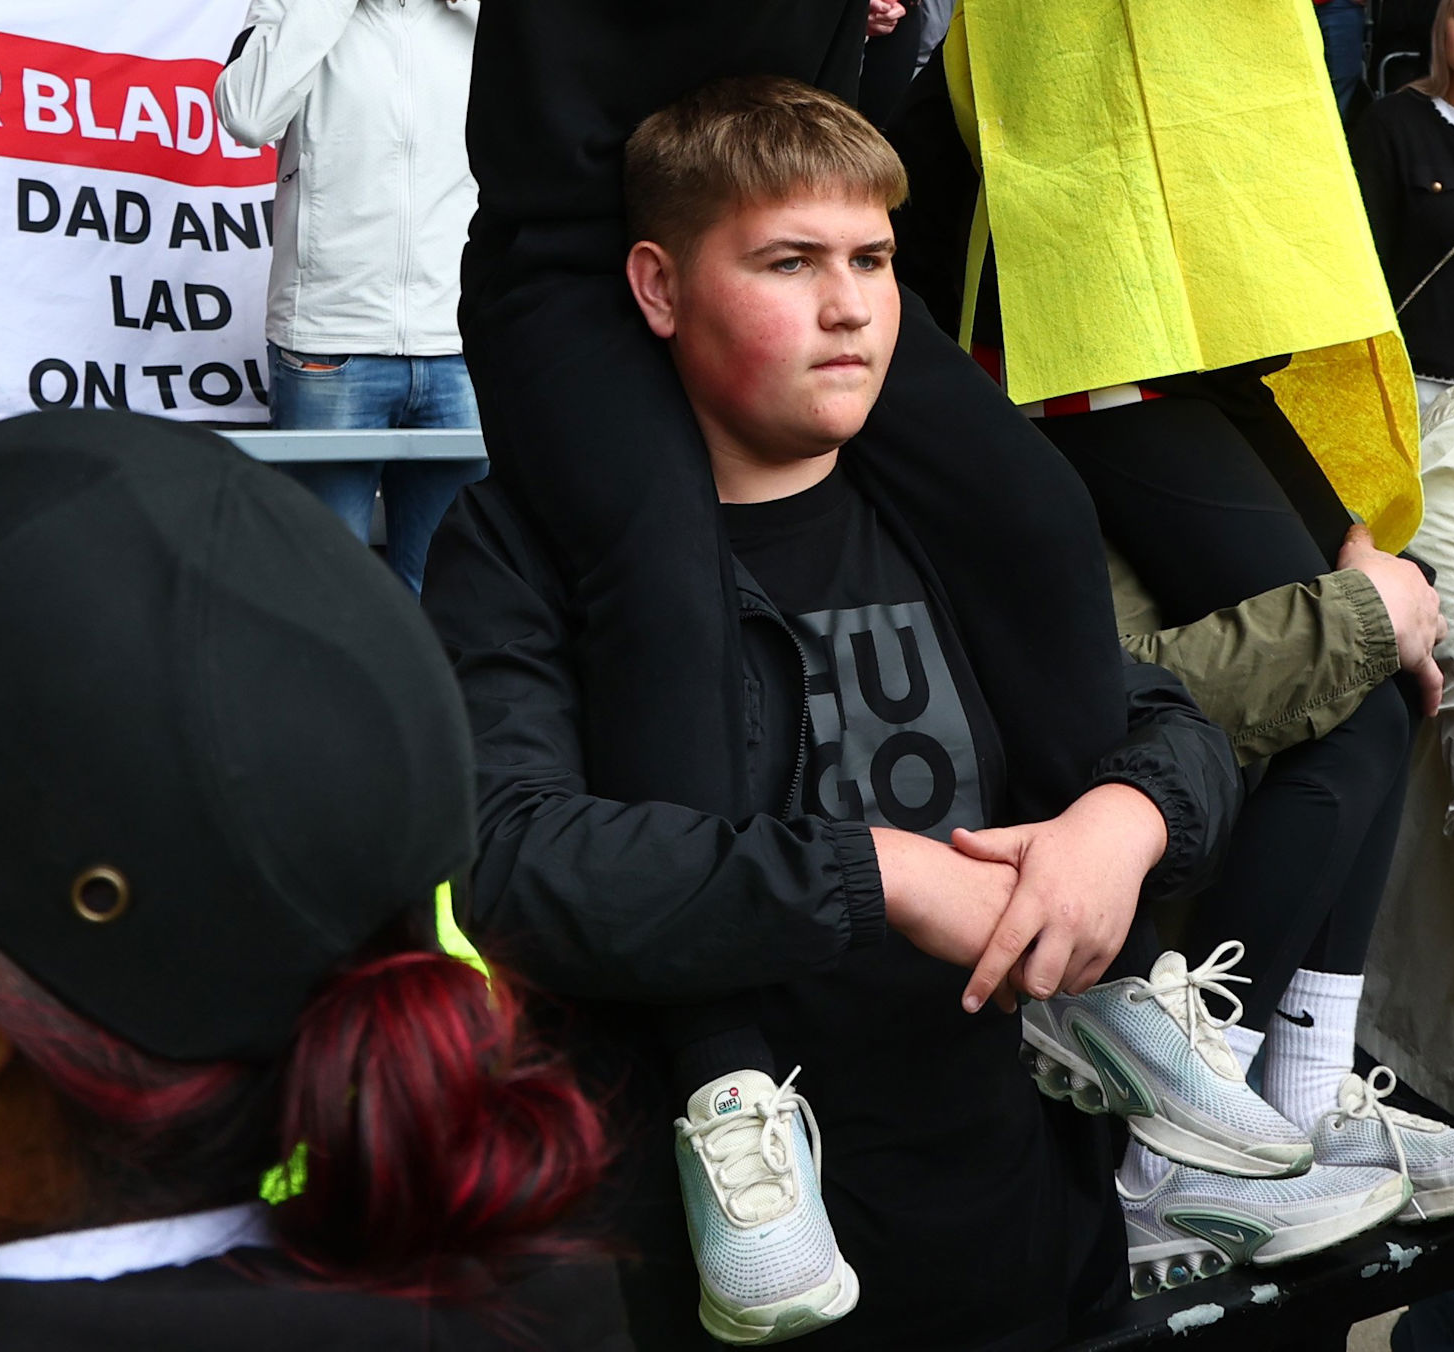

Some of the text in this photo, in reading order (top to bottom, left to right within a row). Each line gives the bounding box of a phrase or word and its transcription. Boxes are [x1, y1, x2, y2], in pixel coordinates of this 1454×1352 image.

[17, 177, 152, 245] DAD
[109, 275, 233, 333] LAD
[28, 357, 131, 412] ON
